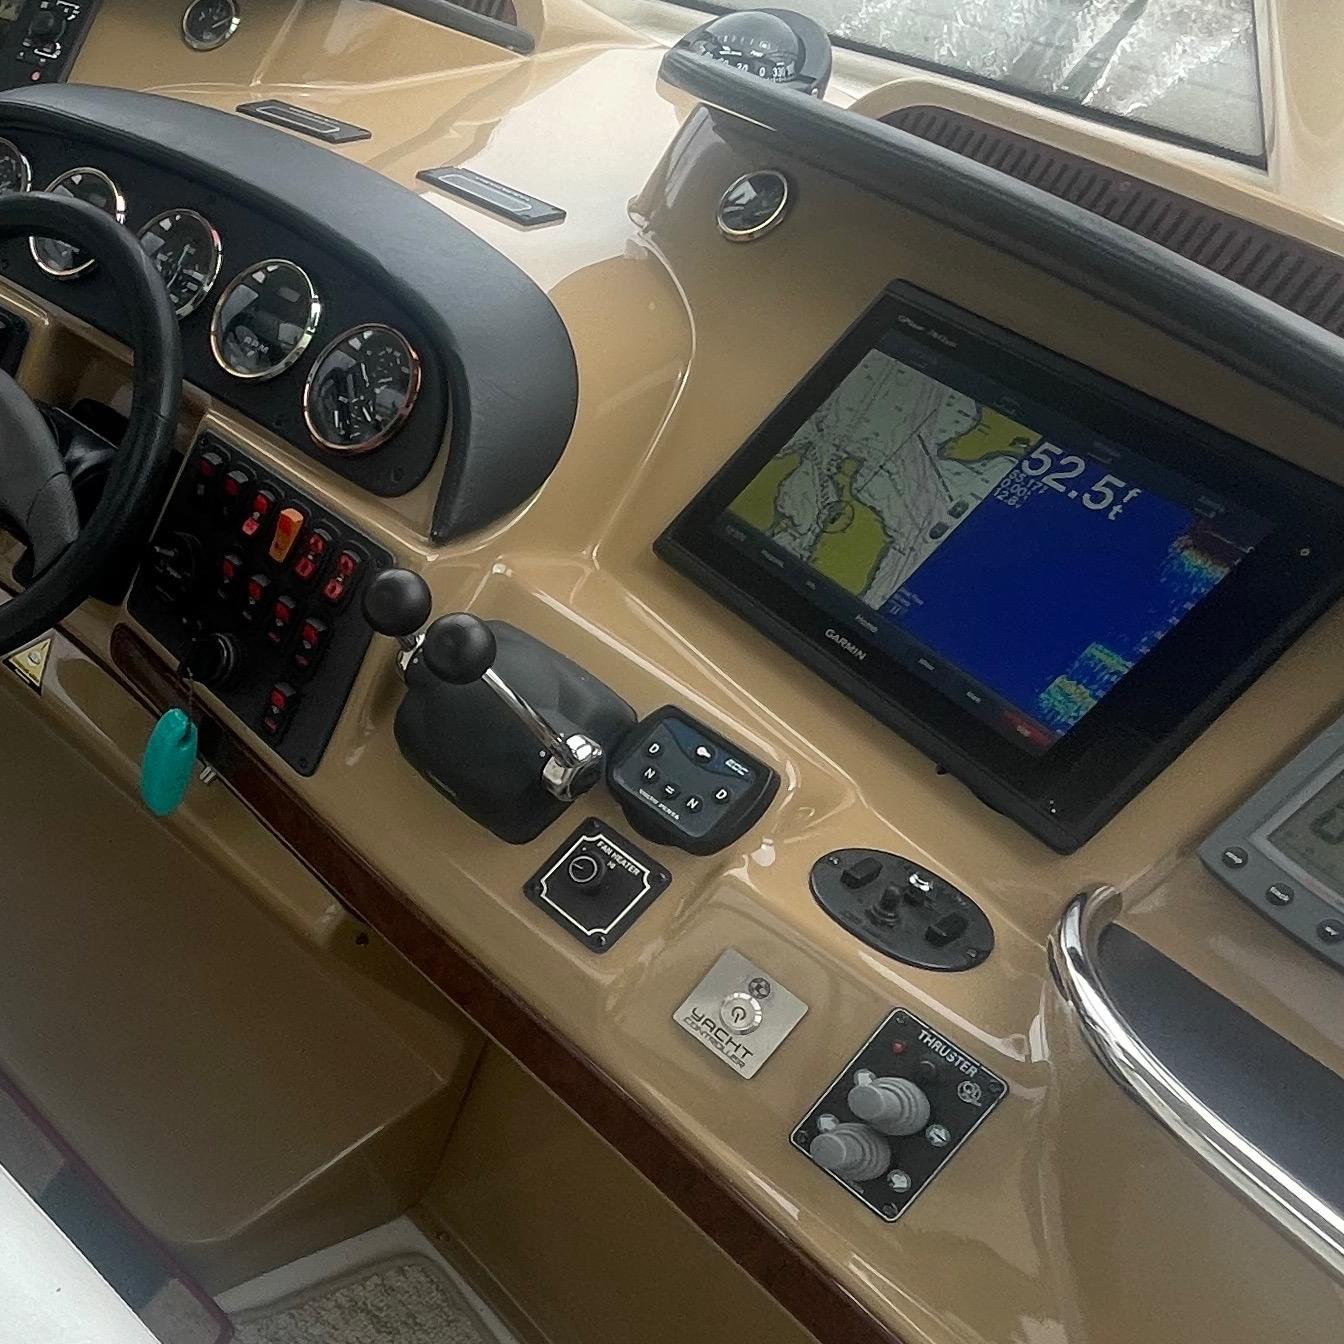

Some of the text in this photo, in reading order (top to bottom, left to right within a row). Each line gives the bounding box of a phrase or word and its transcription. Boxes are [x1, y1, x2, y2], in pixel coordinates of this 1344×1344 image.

[1021, 442, 1127, 510] 52.5
[825, 628, 867, 660] GARMIN
[648, 743, 660, 754] D
[644, 767, 656, 779] N
[686, 797, 699, 809] N
[715, 788, 728, 800] D
[596, 840, 641, 876] FAN HEATER
[683, 1016, 746, 1069] CONTROLLER
[691, 1007, 754, 1059] YACHT
[917, 1029, 978, 1078] THRUSTER
